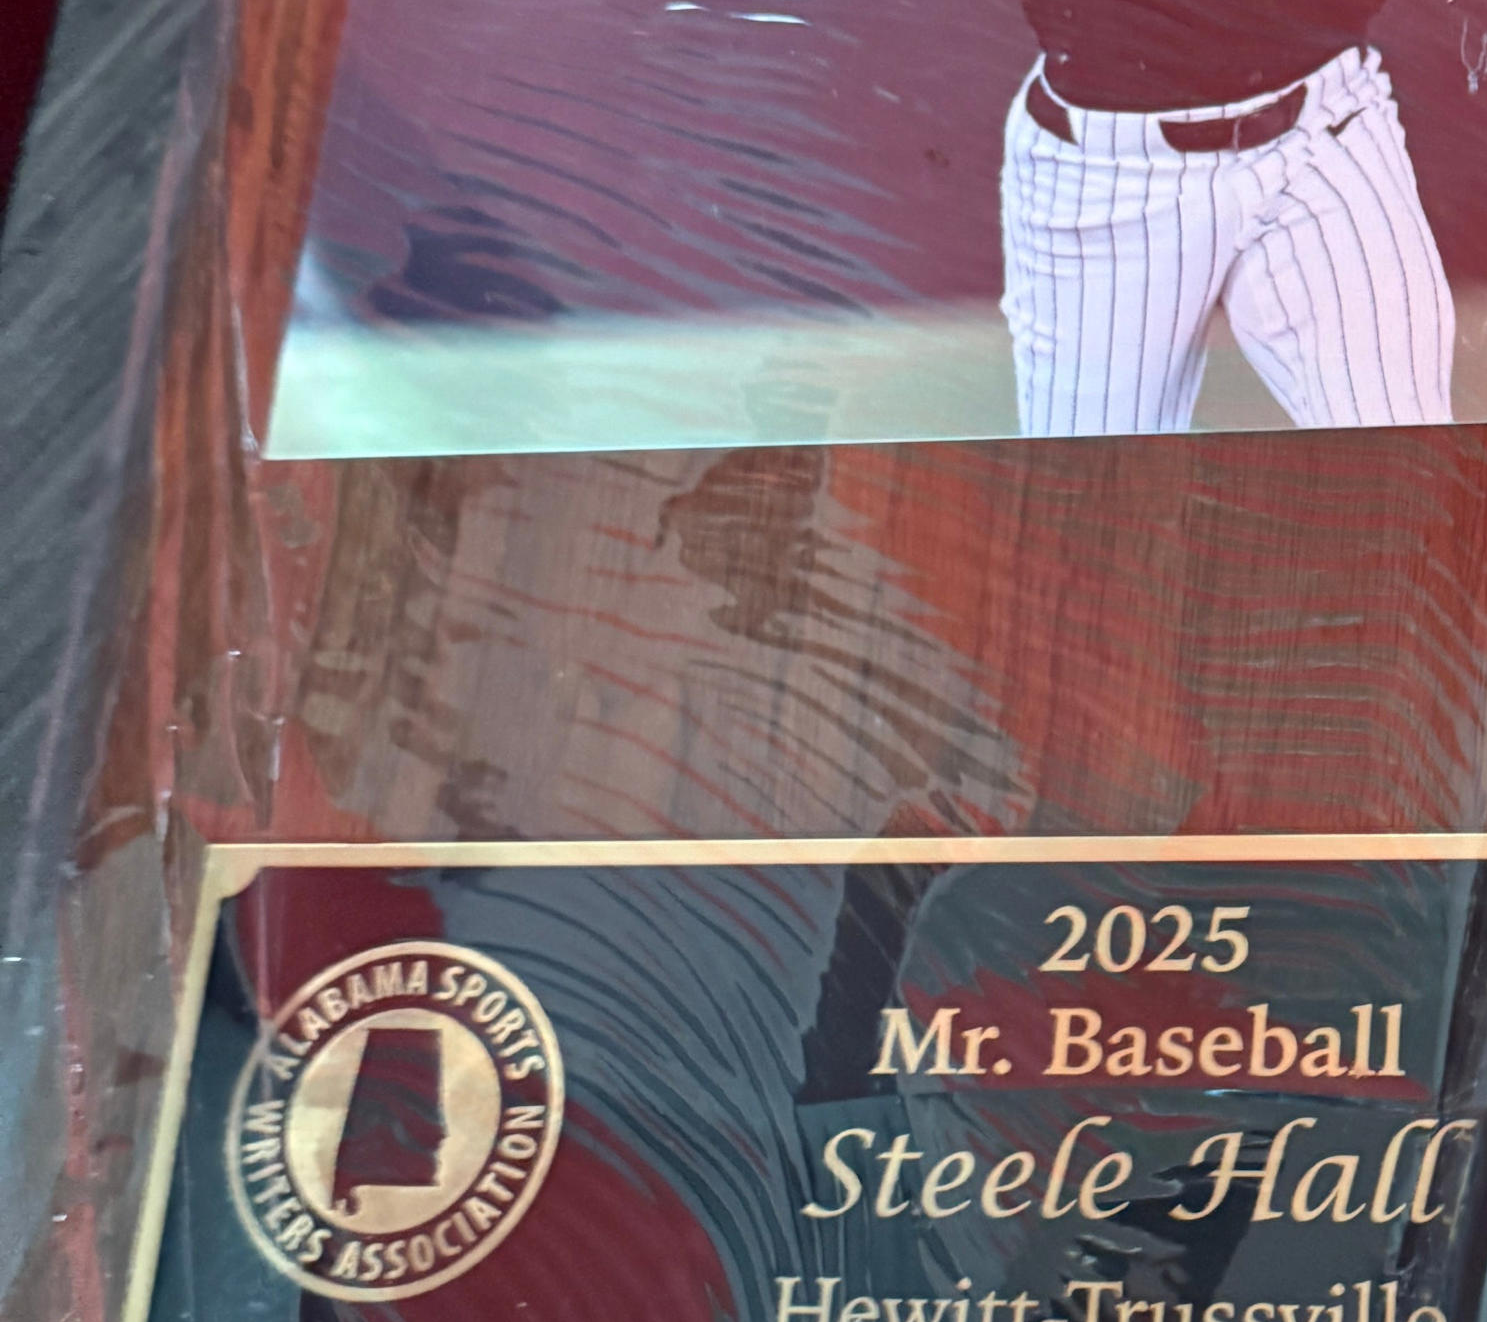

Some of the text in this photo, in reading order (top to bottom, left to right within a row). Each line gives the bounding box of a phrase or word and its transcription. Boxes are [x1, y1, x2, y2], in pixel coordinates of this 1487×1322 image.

[1038, 904, 1252, 975] 2025
[269, 960, 546, 1080] ALABAMA SPORTS
[868, 1003, 1406, 1078] Mr. Baseball
[242, 1100, 546, 1281] WRITERS ASSOCIATION
[801, 1115, 1479, 1225] Steele Hall
